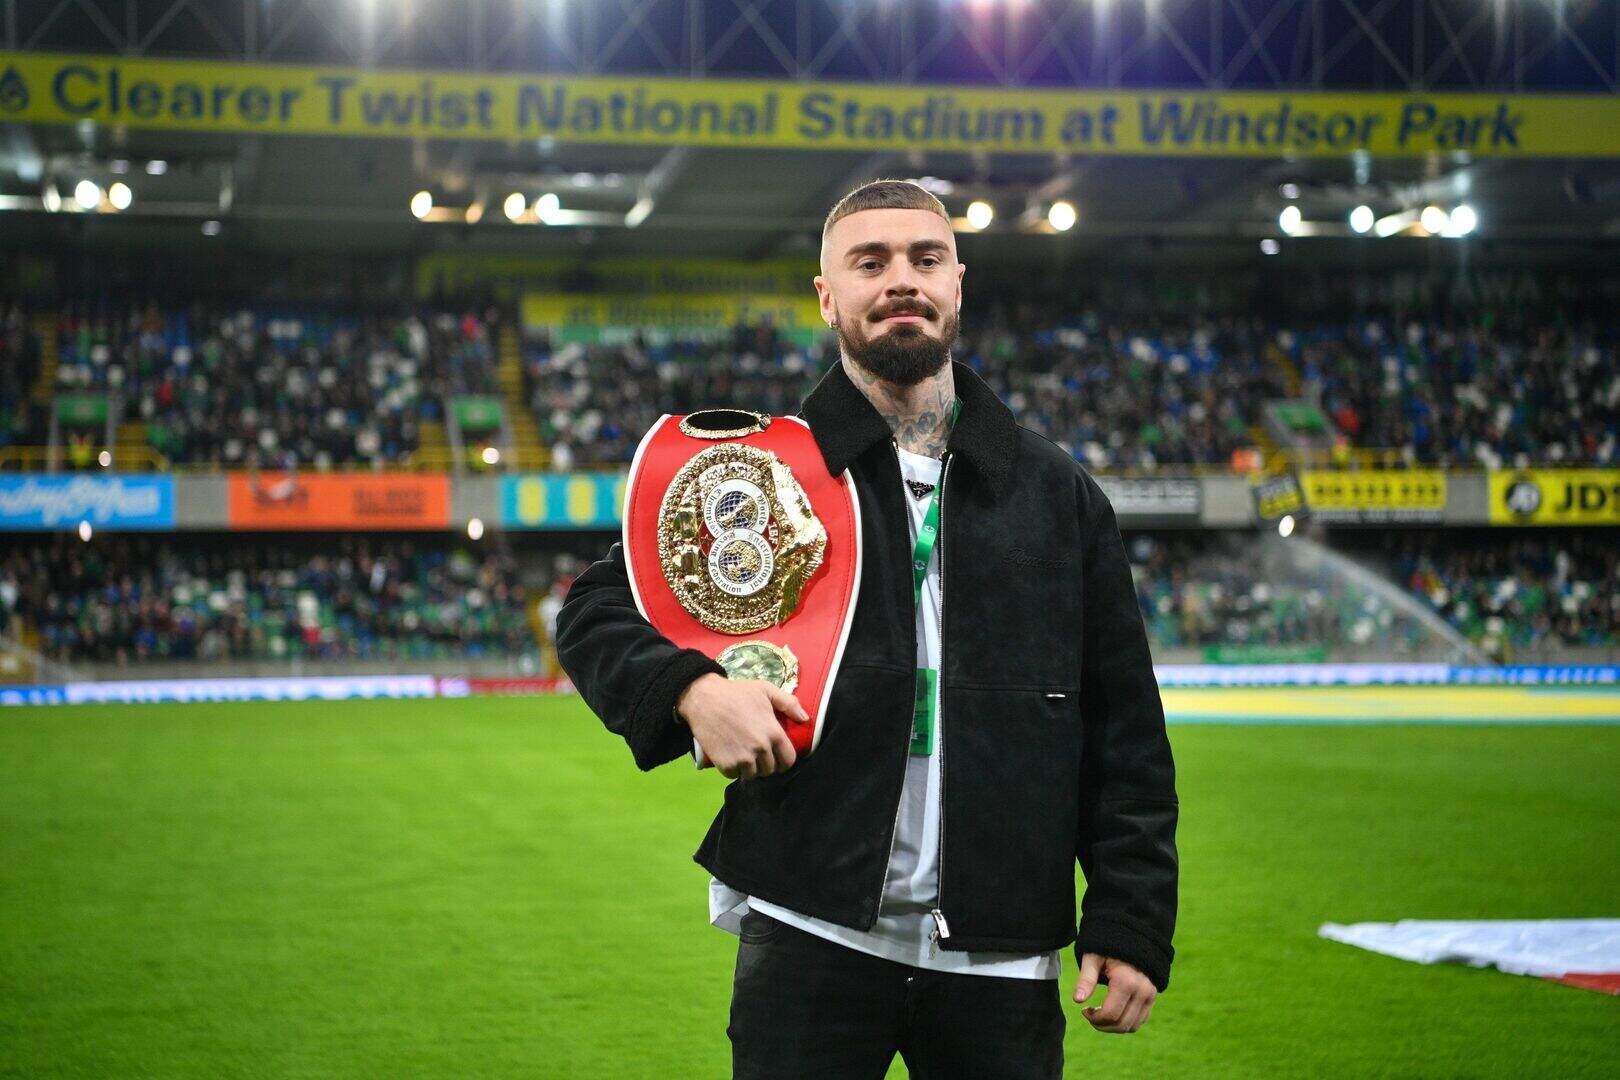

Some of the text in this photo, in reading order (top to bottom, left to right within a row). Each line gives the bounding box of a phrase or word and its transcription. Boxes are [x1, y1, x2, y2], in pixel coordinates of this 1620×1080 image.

[51, 63, 1525, 149] Clearer Twist National Stadium at Windsor Park
[767, 521, 779, 545] IBF
